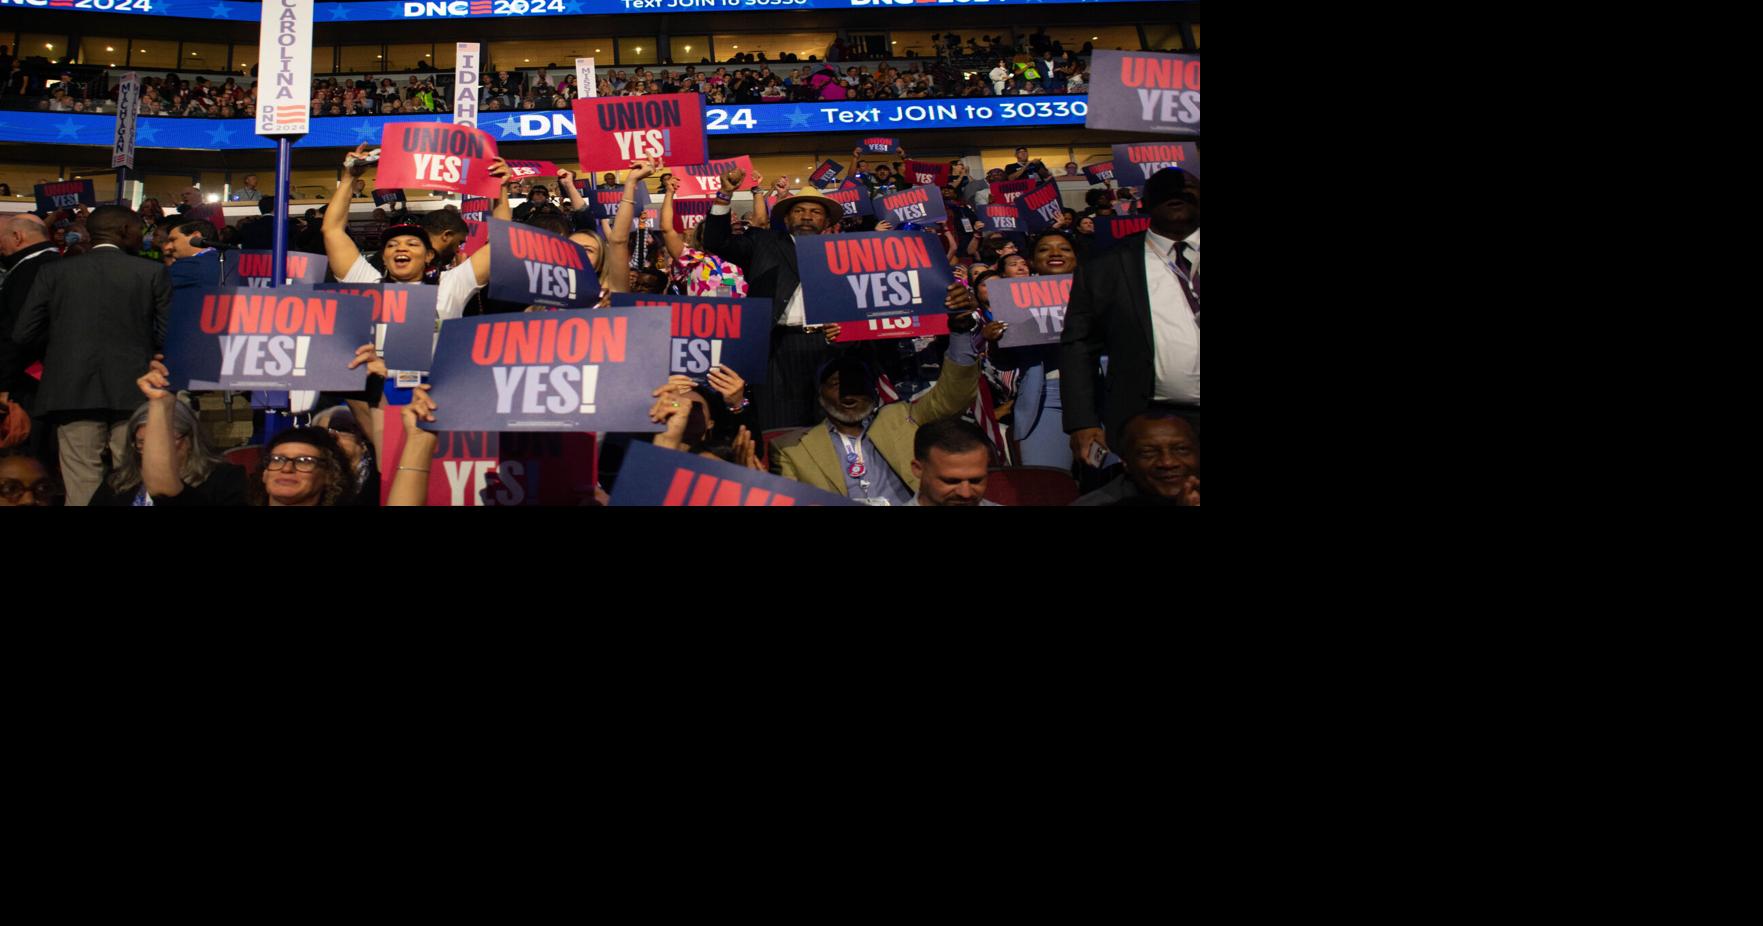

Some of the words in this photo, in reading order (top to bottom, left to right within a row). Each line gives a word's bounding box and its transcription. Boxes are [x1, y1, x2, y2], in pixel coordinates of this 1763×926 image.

[404, 1, 469, 13] DNC
[493, 0, 566, 11] 2024
[116, 83, 130, 153] MICHIGAN
[262, 105, 274, 131] DNC
[597, 99, 681, 132] UNION
[706, 108, 758, 130] 24
[820, 107, 881, 123] Text
[889, 104, 957, 121] JOIN
[965, 105, 993, 119] to
[999, 100, 1087, 119] 30330
[403, 127, 484, 159] UNION
[614, 129, 671, 160] YES!
[868, 143, 888, 151] YES!
[1128, 144, 1185, 164] UNION
[413, 153, 471, 185] YES!
[52, 192, 80, 207] YES!
[883, 188, 929, 212] UNION
[894, 203, 927, 222] YES!
[633, 218, 654, 228] YS!
[992, 216, 1016, 228] YES!
[508, 225, 584, 271] UNION
[824, 235, 932, 275] UNION
[239, 254, 308, 279] UNIN
[524, 259, 577, 300] YES!
[846, 270, 922, 309] YES!
[200, 294, 338, 334] UNION
[1028, 305, 1068, 333] YE
[471, 315, 628, 366] UNION
[218, 335, 311, 376] YES!
[492, 364, 599, 414] YES!
